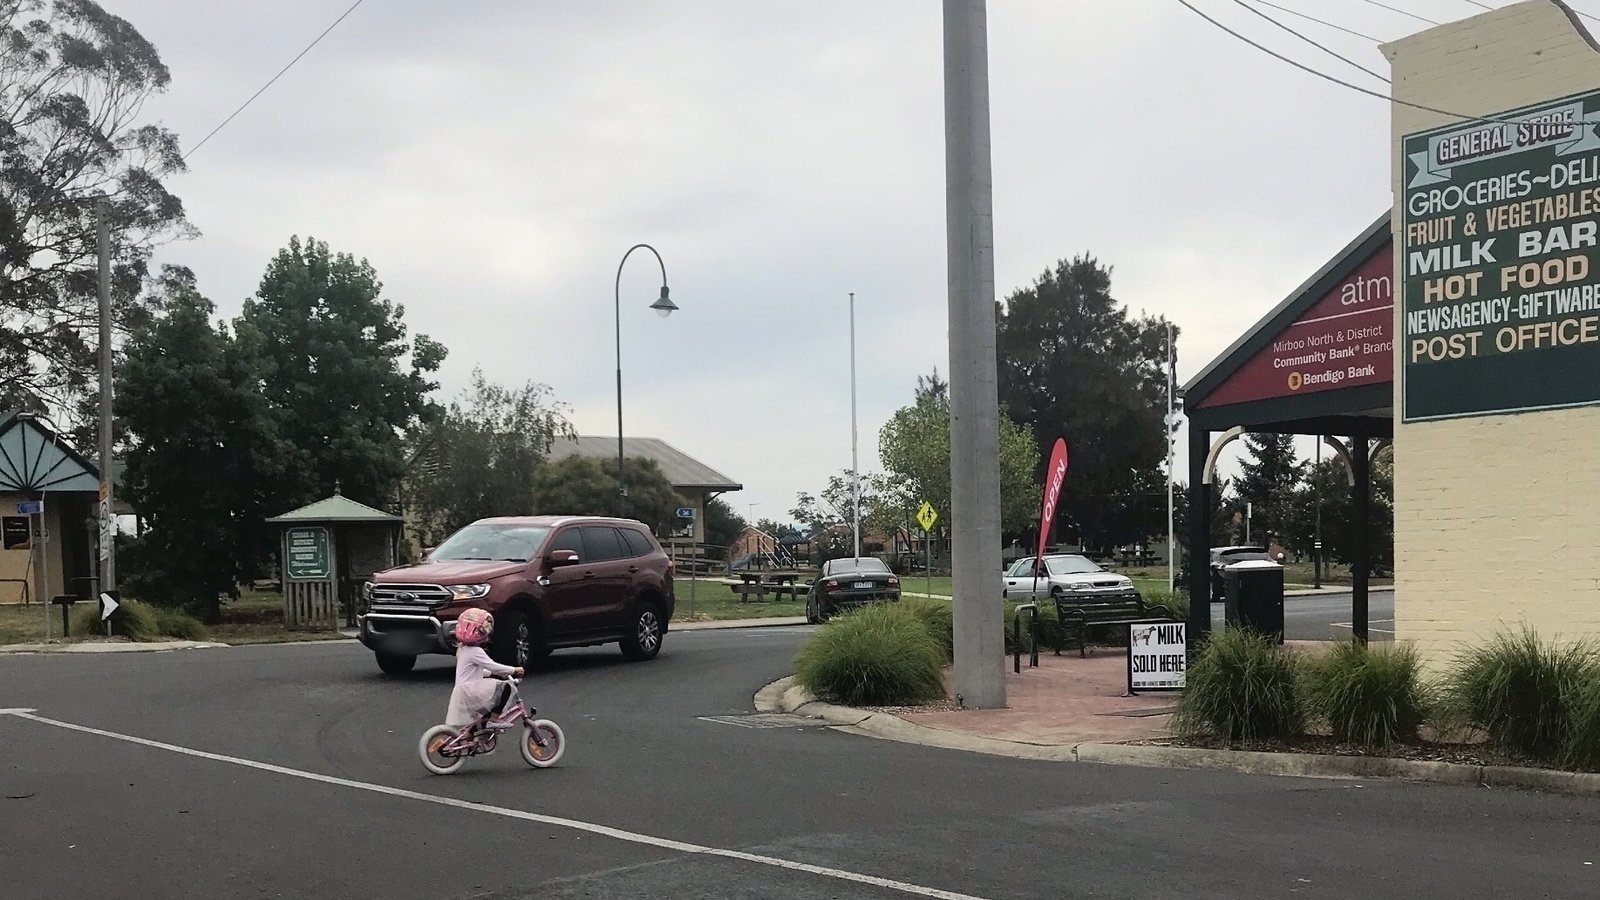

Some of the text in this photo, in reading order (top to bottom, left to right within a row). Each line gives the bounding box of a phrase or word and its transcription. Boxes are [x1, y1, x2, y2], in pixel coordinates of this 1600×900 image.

[1438, 108, 1575, 164] GENERAL STORE
[1407, 187, 1600, 248] FRUIT & VEGETABLES
[1409, 220, 1597, 276] MILK BAR
[1341, 276, 1390, 305] atm
[1424, 254, 1589, 304] HOT FOOD
[1273, 324, 1383, 353] Mirboo North & District
[1273, 350, 1327, 368] Community
[1363, 341, 1393, 354] Branc
[1412, 315, 1599, 363] POST OFFICE
[1303, 363, 1375, 384] Bendigo Bank
[1045, 457, 1066, 522] OPEN
[1158, 625, 1184, 645] MILK
[1133, 654, 1184, 673] SOLD HERE
